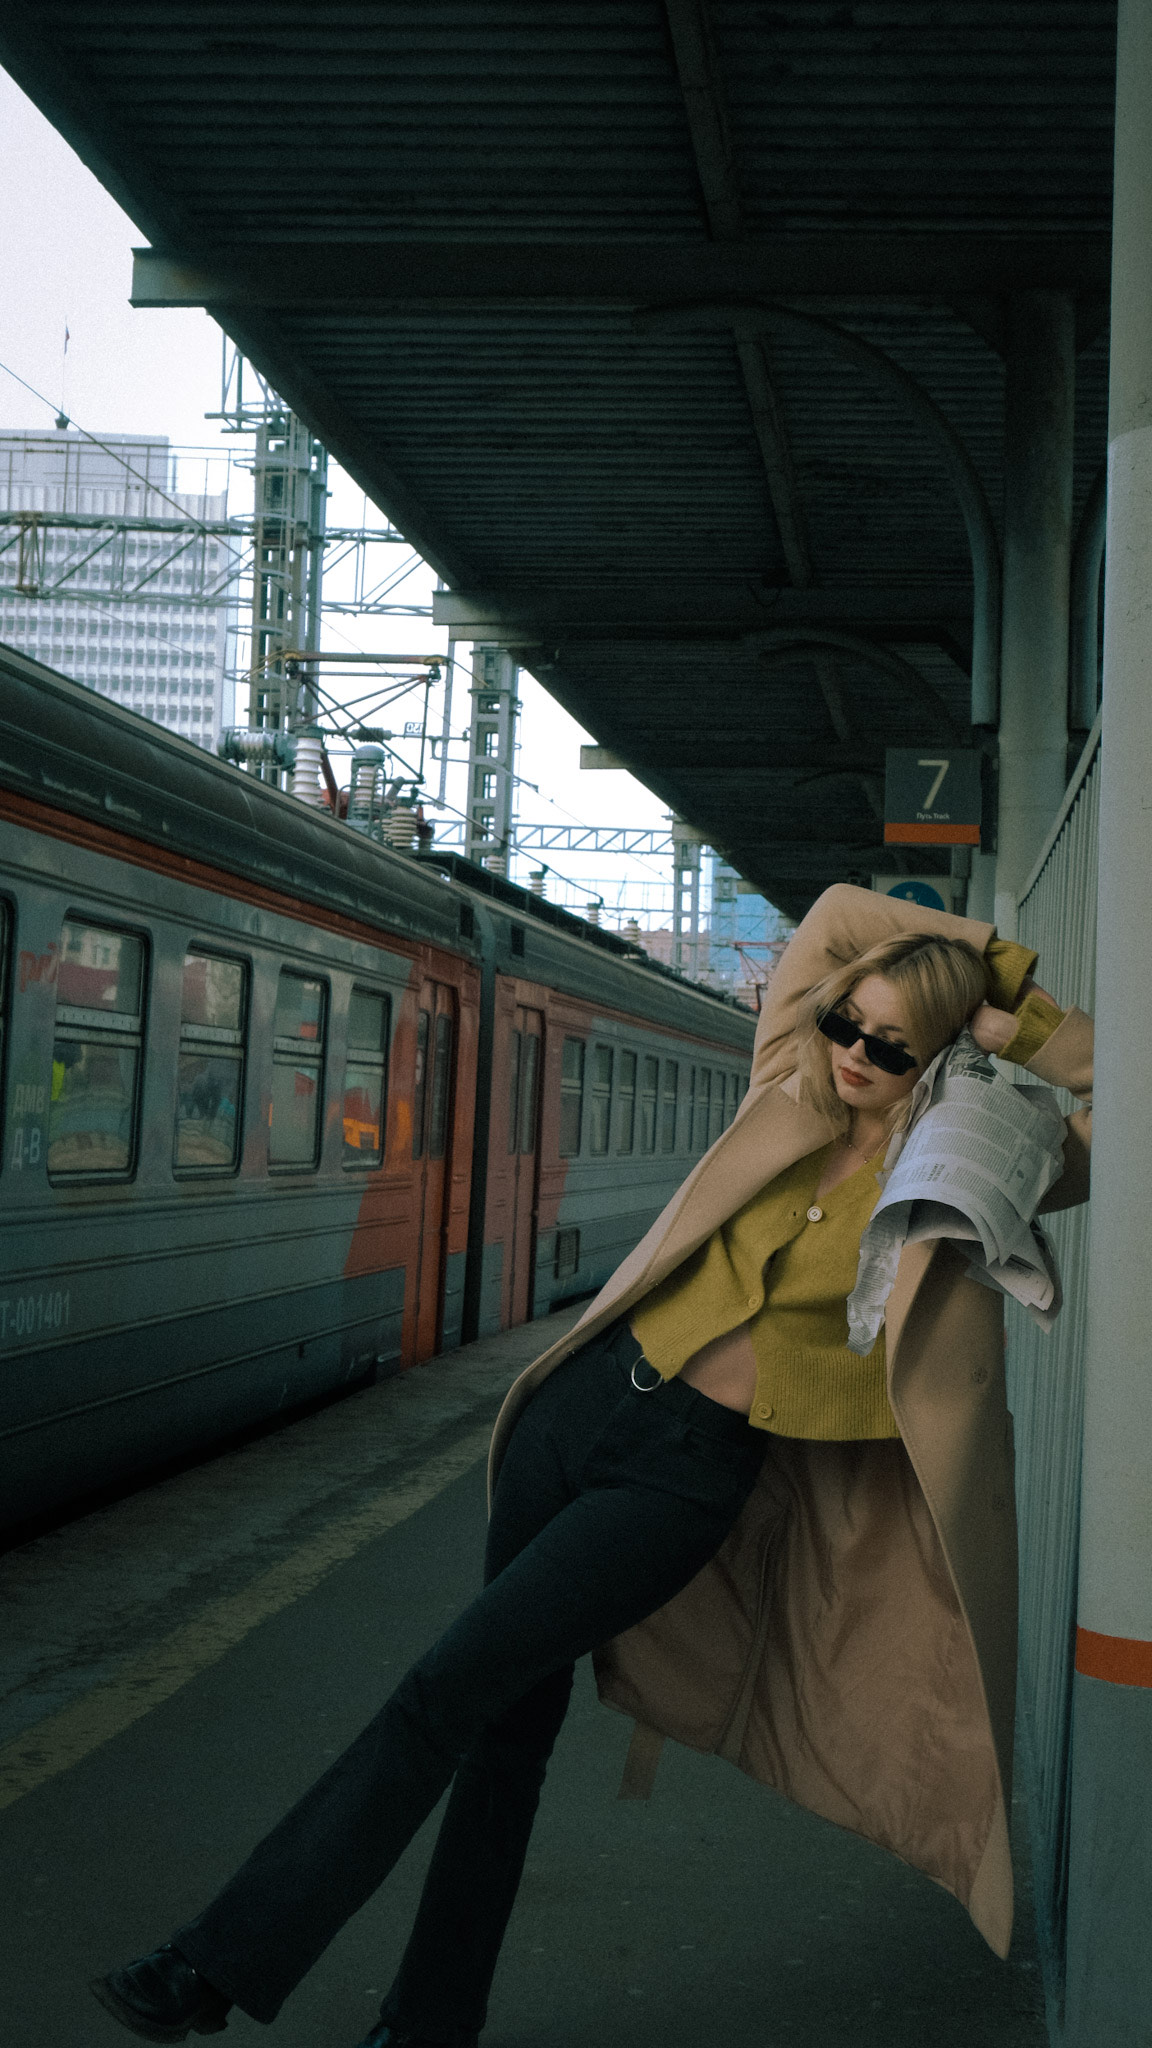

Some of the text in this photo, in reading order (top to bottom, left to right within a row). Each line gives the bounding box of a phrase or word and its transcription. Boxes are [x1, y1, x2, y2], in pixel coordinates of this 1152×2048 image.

[917, 759, 950, 810] 7
[916, 812, 950, 821] Путь Track
